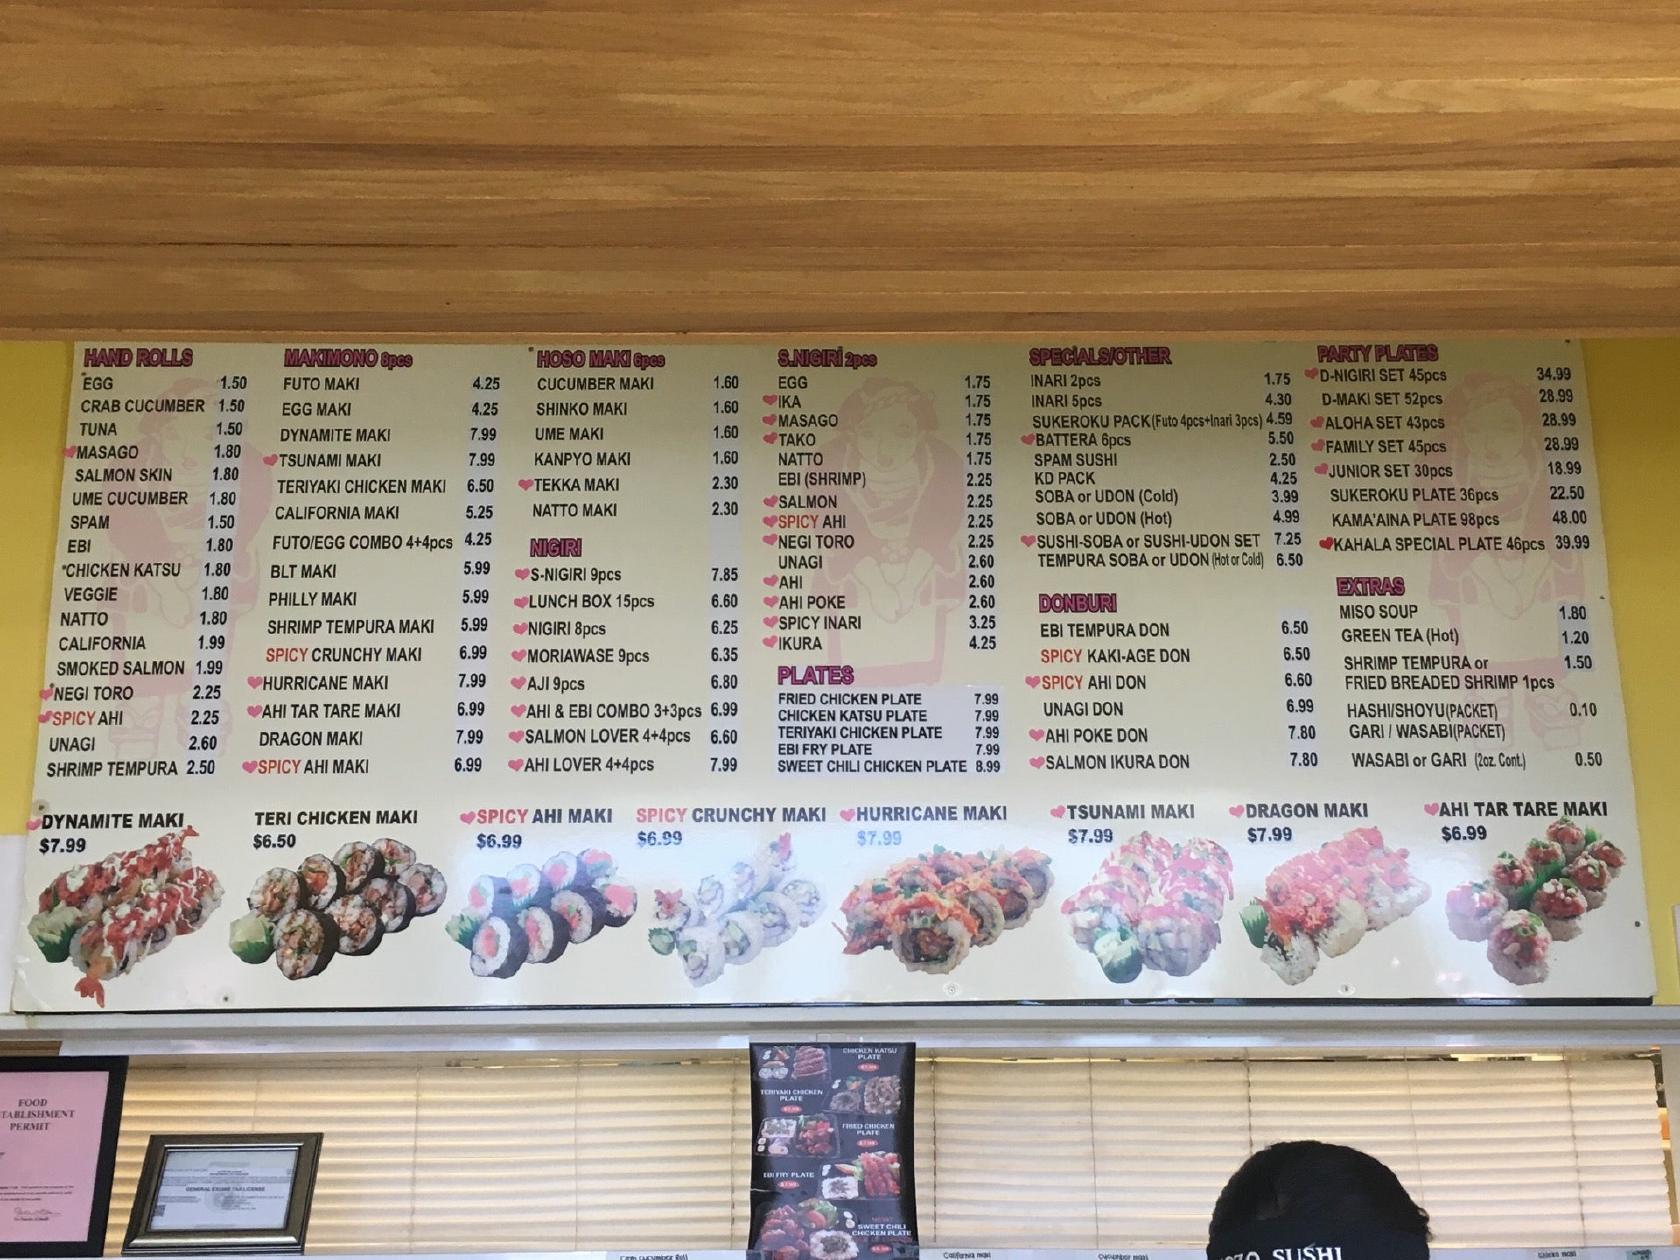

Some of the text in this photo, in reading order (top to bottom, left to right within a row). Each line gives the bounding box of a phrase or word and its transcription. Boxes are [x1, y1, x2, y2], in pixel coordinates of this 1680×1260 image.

[84, 348, 193, 367] HAND ROLLS
[284, 348, 413, 370] MAKIMONO 8pcs
[537, 350, 665, 370] HOSO MAKI 6pcs
[778, 349, 877, 369] S.NIGIRI 2pcs
[1029, 347, 1172, 366] SPECIALS/OTHER
[1317, 344, 1439, 363] PARTY PLATES
[83, 376, 247, 390] EGG 1.50
[284, 377, 500, 390] FUTO MAKI 4.25
[538, 376, 738, 390] CUCUMBER MAKI 1.60
[779, 375, 990, 389] EGG 1.75
[1031, 372, 1290, 389] INARI 2pcs 1.75
[80, 422, 242, 436] TUNA 1.50
[1326, 413, 1576, 431] ALOHA SET 43pcs 28.99
[1035, 453, 1295, 466] SPAM SUSHI 2.50
[75, 467, 239, 482] SALMON SKIN 1.80
[779, 472, 992, 488] EBI (SHRIMP) 2.25
[276, 506, 493, 520] CALIFORNIA MAKI 5.25
[533, 502, 738, 517] NATTO MAKI 2.30
[1332, 509, 1587, 528] KAMA'AINA PLATE 98pcs 48.00
[530, 538, 582, 557] NIGIRI
[1336, 577, 1405, 596] EXTRAS
[269, 589, 489, 606] PHILLY MAKI 5.99
[529, 594, 738, 610] LUNCH BOX 15pcs 6.60
[1039, 593, 1117, 613] DONBURI
[1340, 605, 1586, 620] MISO SOUP 1.80
[1041, 621, 1308, 637] EBI TEMPURA DON 6.50
[59, 635, 225, 651] CALIFORNIA 1.99
[779, 636, 996, 650] IKURA 4.25
[778, 665, 854, 685] PLATES
[528, 675, 737, 692] AJI 9pcs 6.80
[1044, 699, 1313, 716] UNAGI DON 6.99
[260, 730, 483, 746] DRAGON MAKI 7.99
[779, 744, 1000, 755] EBI FRY PLATE 7.99
[1352, 753, 1409, 767] WASABI
[1413, 757, 1427, 767] or
[1431, 753, 1466, 767] GARI
[1575, 752, 1602, 766] 0.50
[47, 760, 214, 777] SHRIMP TEMPURA 2.50
[478, 809, 612, 824] SPICY AHI MAKI
[637, 807, 825, 822] SPICY CRUNCHY MAKI
[857, 806, 1006, 821] HURRICANE MAKI
[1067, 804, 1194, 819] TSUNAMI MAKI
[1246, 803, 1368, 818] DRAGON MAKI
[1440, 802, 1607, 816] AHI TAR TARE MAKI
[42, 813, 185, 829] DYNAMITE MAKI
[255, 810, 417, 825] TERI CHICKEN MAKI
[638, 831, 682, 846] $6.99
[858, 831, 902, 846] $7.99
[1069, 829, 1113, 844] $7.99
[1248, 827, 1292, 843] $7.99
[1442, 825, 1487, 842] $6.99
[39, 838, 86, 854] $7.99
[253, 834, 296, 849] $6.50
[477, 834, 522, 849] $6.99
[18, 1098, 48, 1107] FOOD
[9, 1122, 50, 1131] PERMIT
[1273, 1247, 1341, 1260] SUSHI
